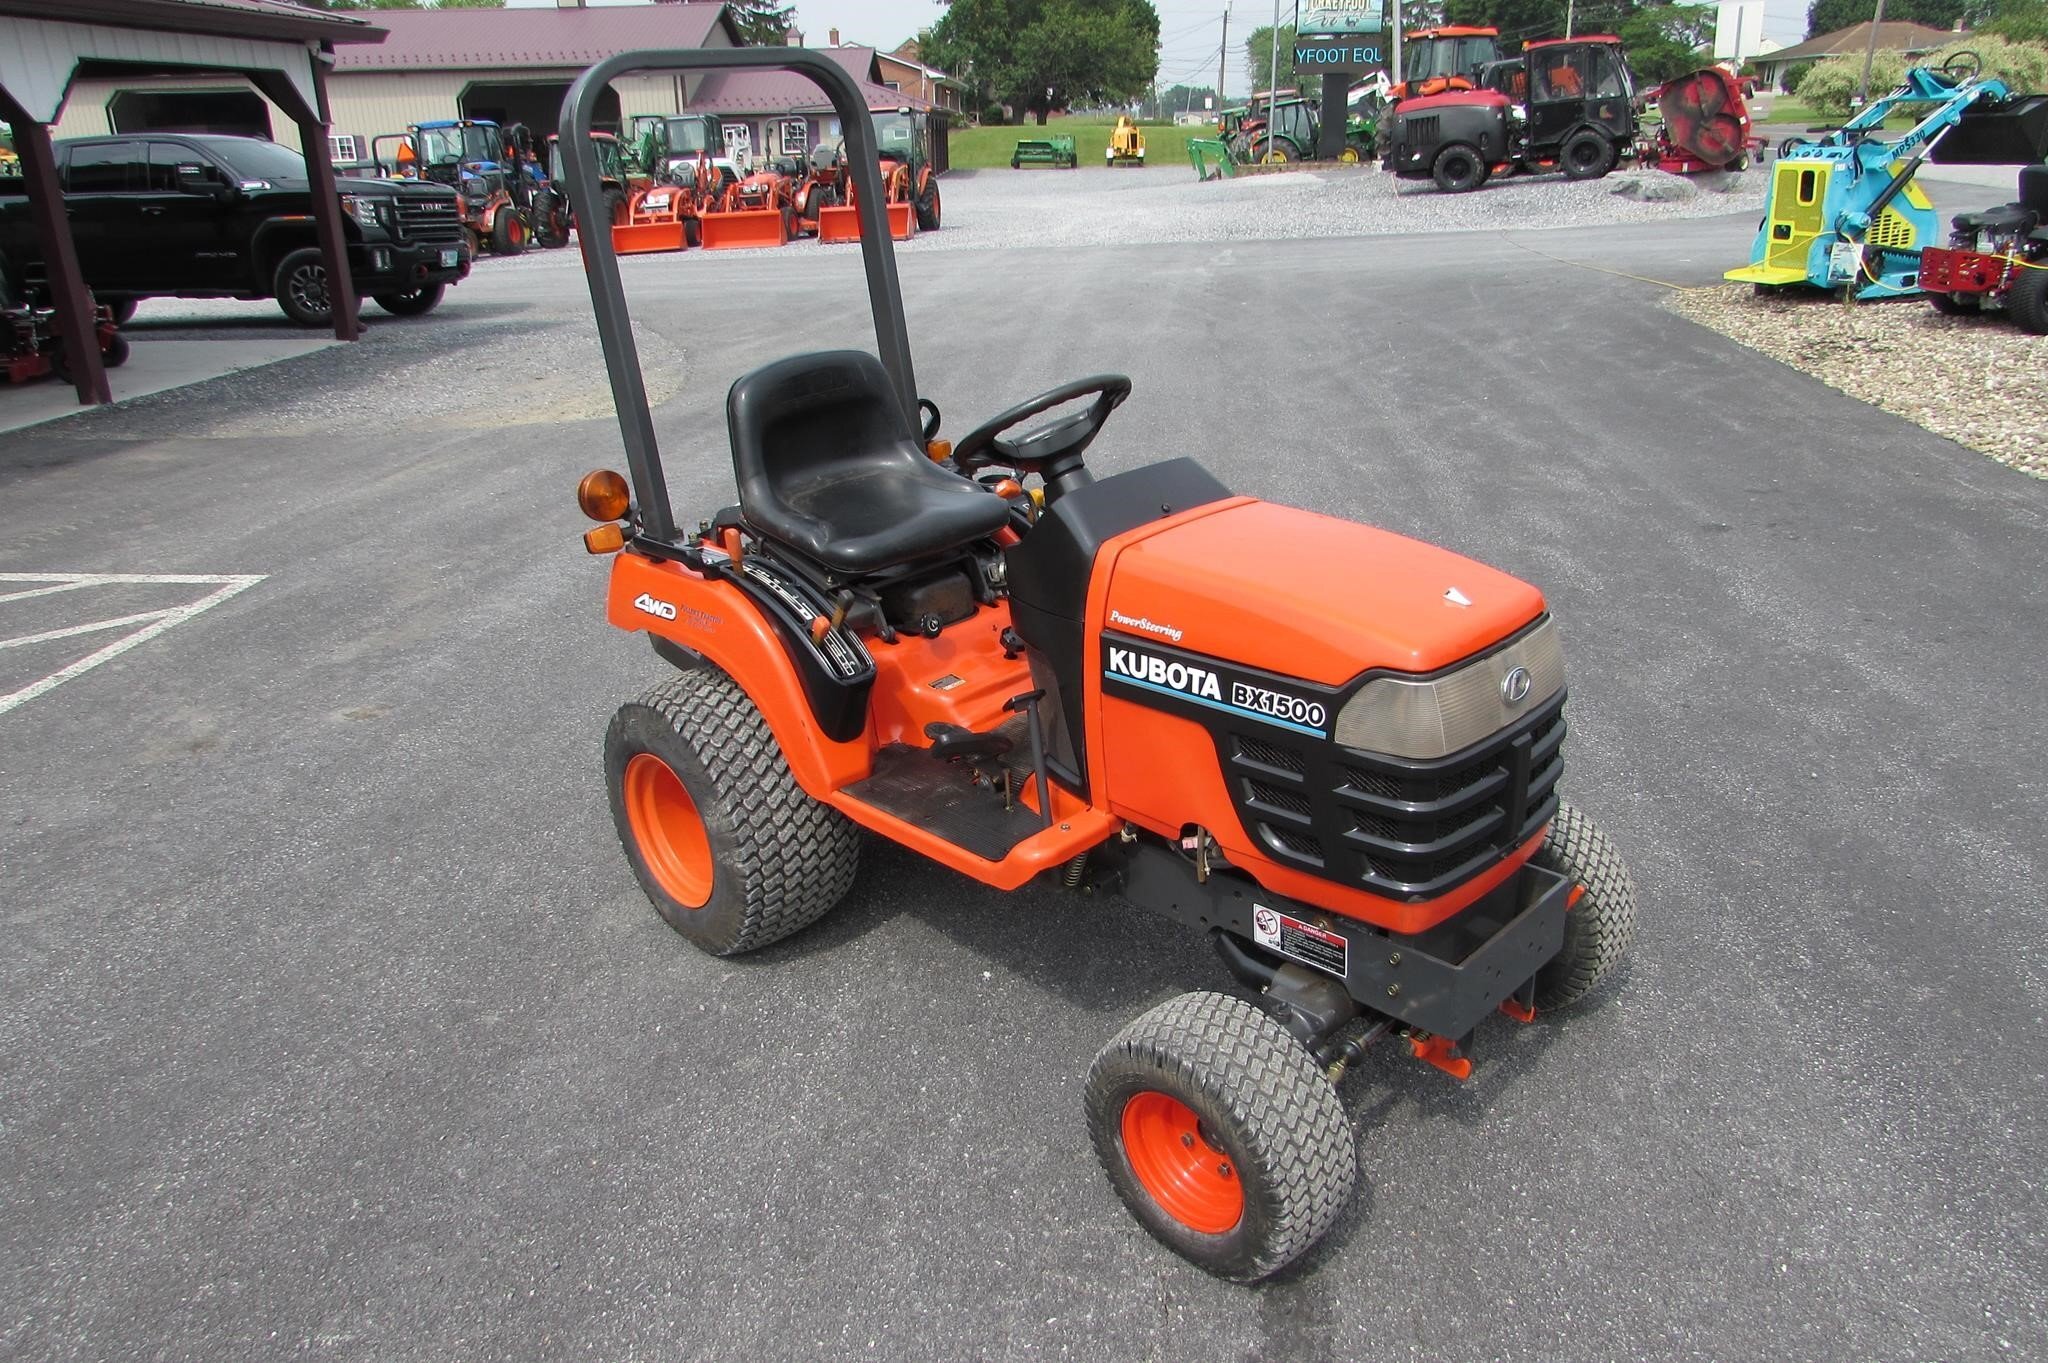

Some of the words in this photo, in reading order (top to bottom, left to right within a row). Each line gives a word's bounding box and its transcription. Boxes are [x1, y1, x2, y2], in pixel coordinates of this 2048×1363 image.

[1296, 47, 1349, 64] YFOOT
[633, 591, 677, 621] 4WD
[1110, 610, 1183, 641] PowerSteering
[1109, 646, 1222, 701] KUBOTA
[1231, 681, 1326, 727] BX1500
[1303, 925, 1327, 940] DANGER
